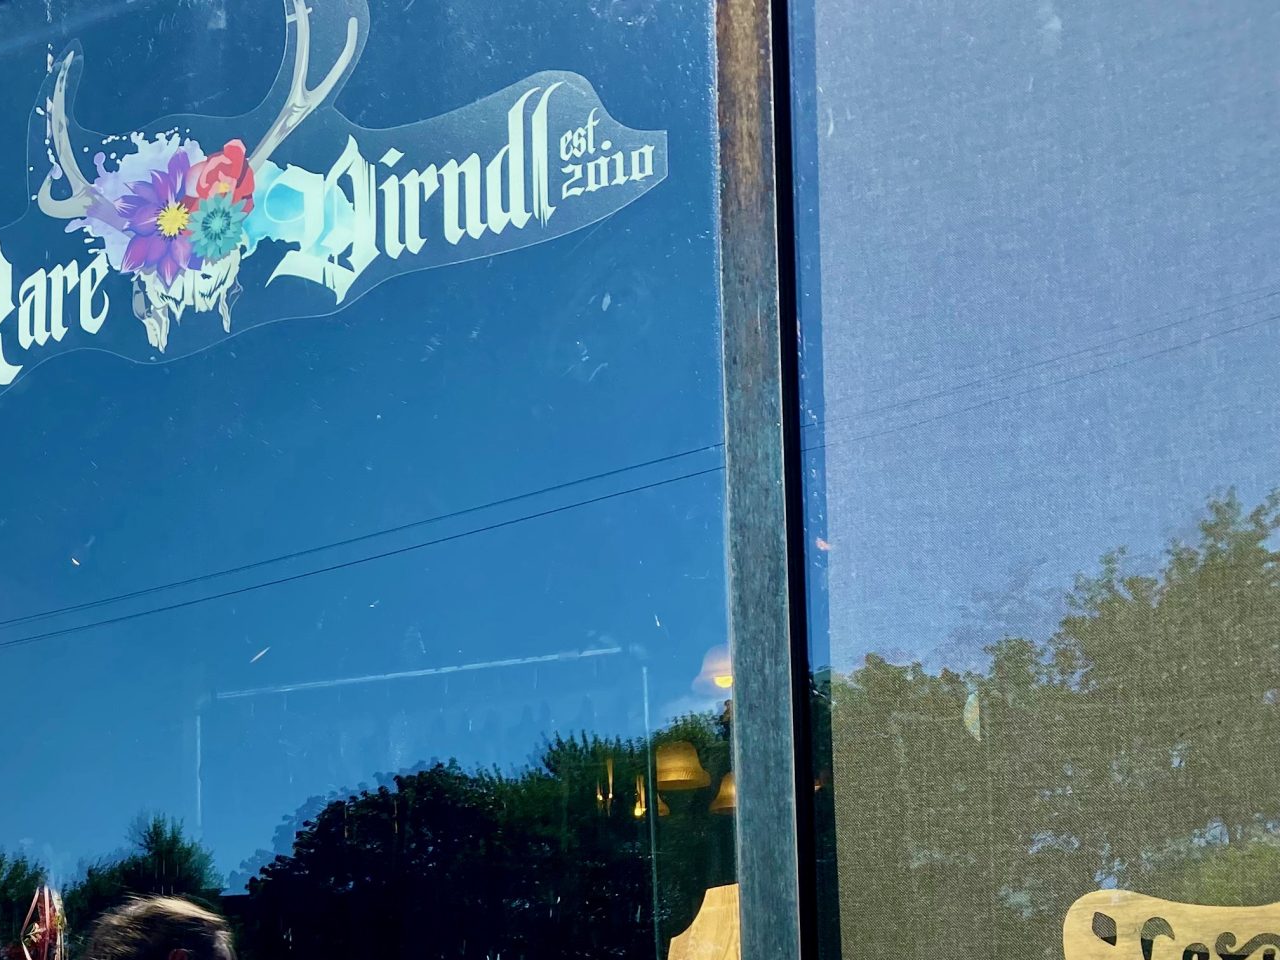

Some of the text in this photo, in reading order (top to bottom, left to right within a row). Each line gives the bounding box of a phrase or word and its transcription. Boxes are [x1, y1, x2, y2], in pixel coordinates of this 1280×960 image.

[559, 107, 600, 161] est
[265, 81, 565, 305] Dirndl
[561, 140, 655, 199] 2010
